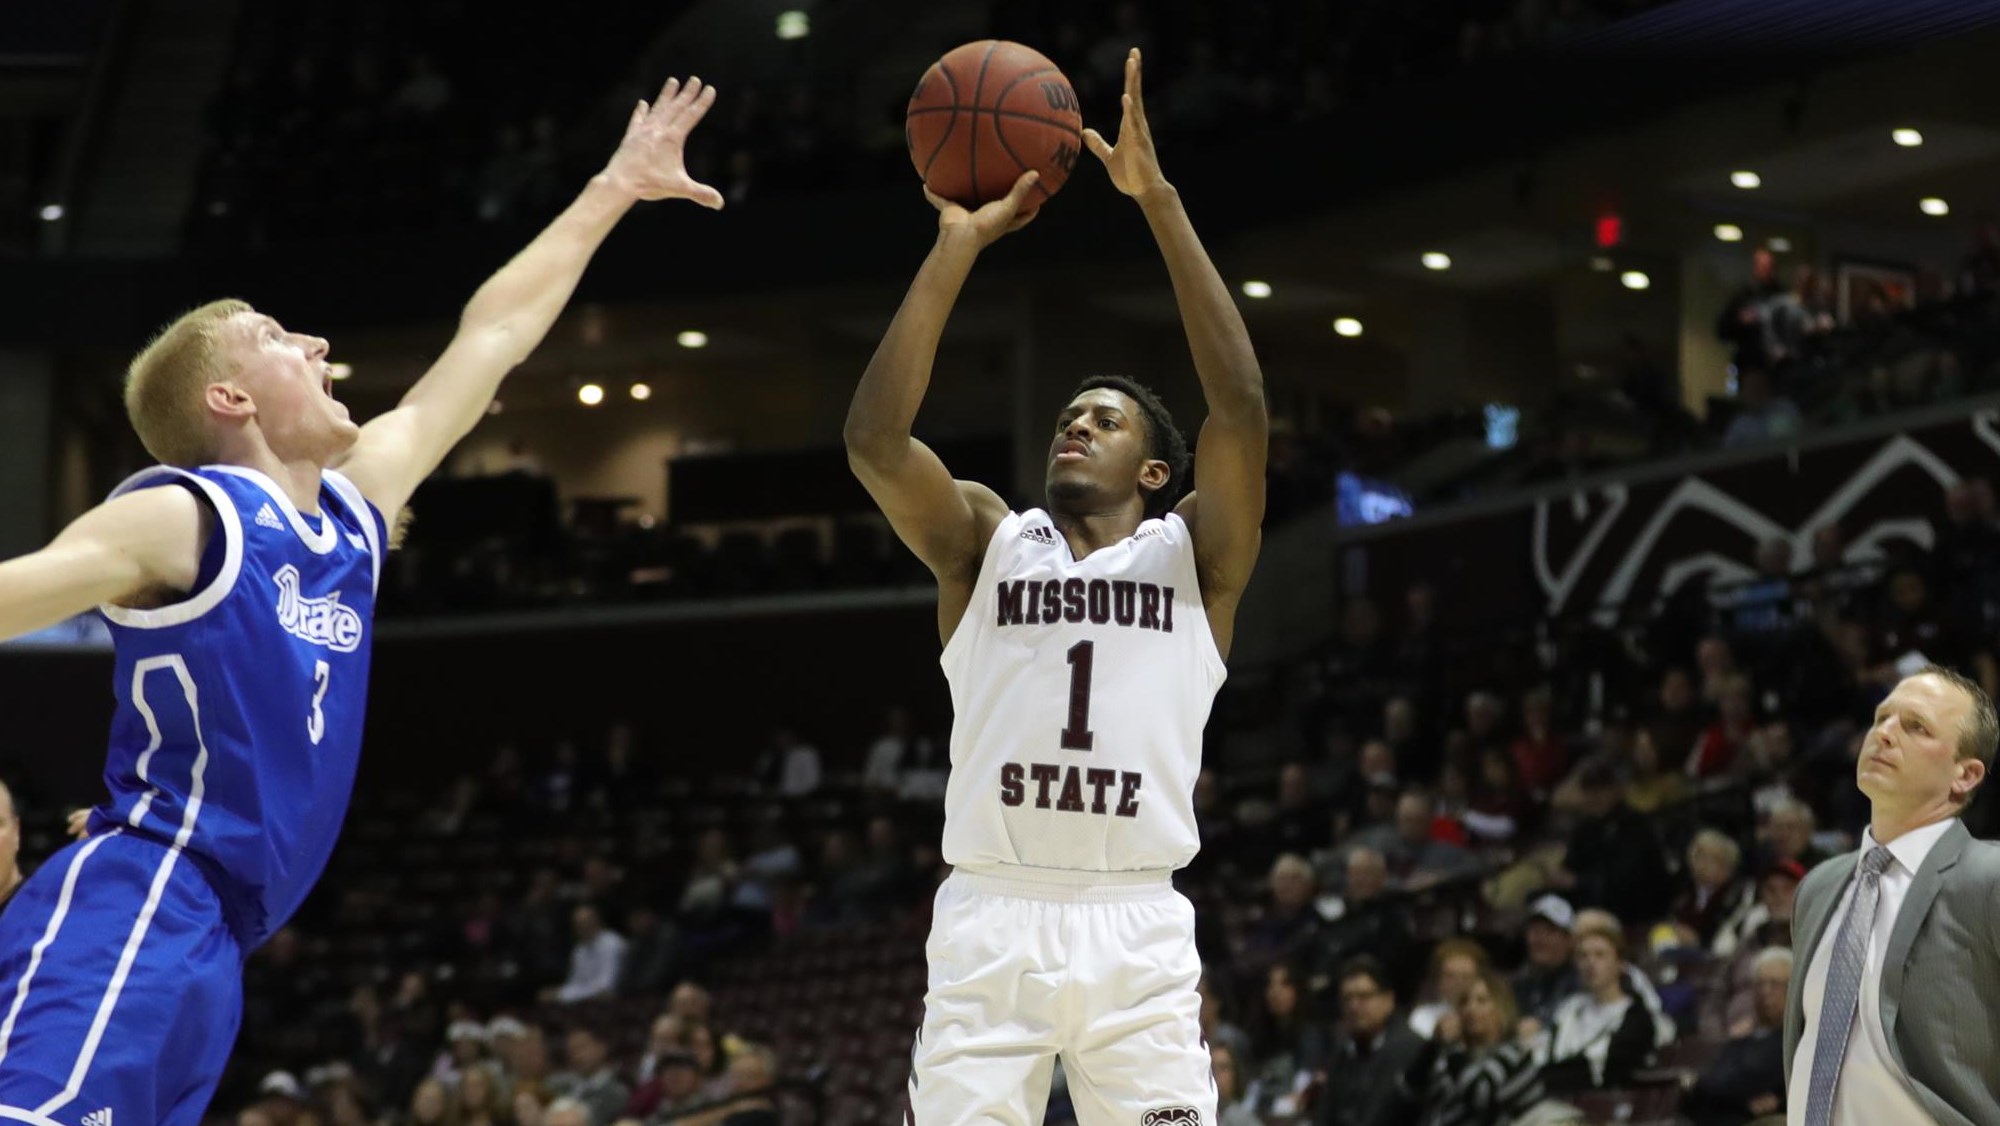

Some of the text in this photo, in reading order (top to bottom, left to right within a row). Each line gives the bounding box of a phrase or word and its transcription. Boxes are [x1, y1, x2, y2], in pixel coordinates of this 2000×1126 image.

[1020, 531, 1057, 546] adidas
[273, 563, 362, 652] Drake
[997, 578, 1175, 633] MISSOURI
[307, 659, 330, 745] 3
[1061, 640, 1094, 751] 1
[1001, 762, 1142, 818] STATE
